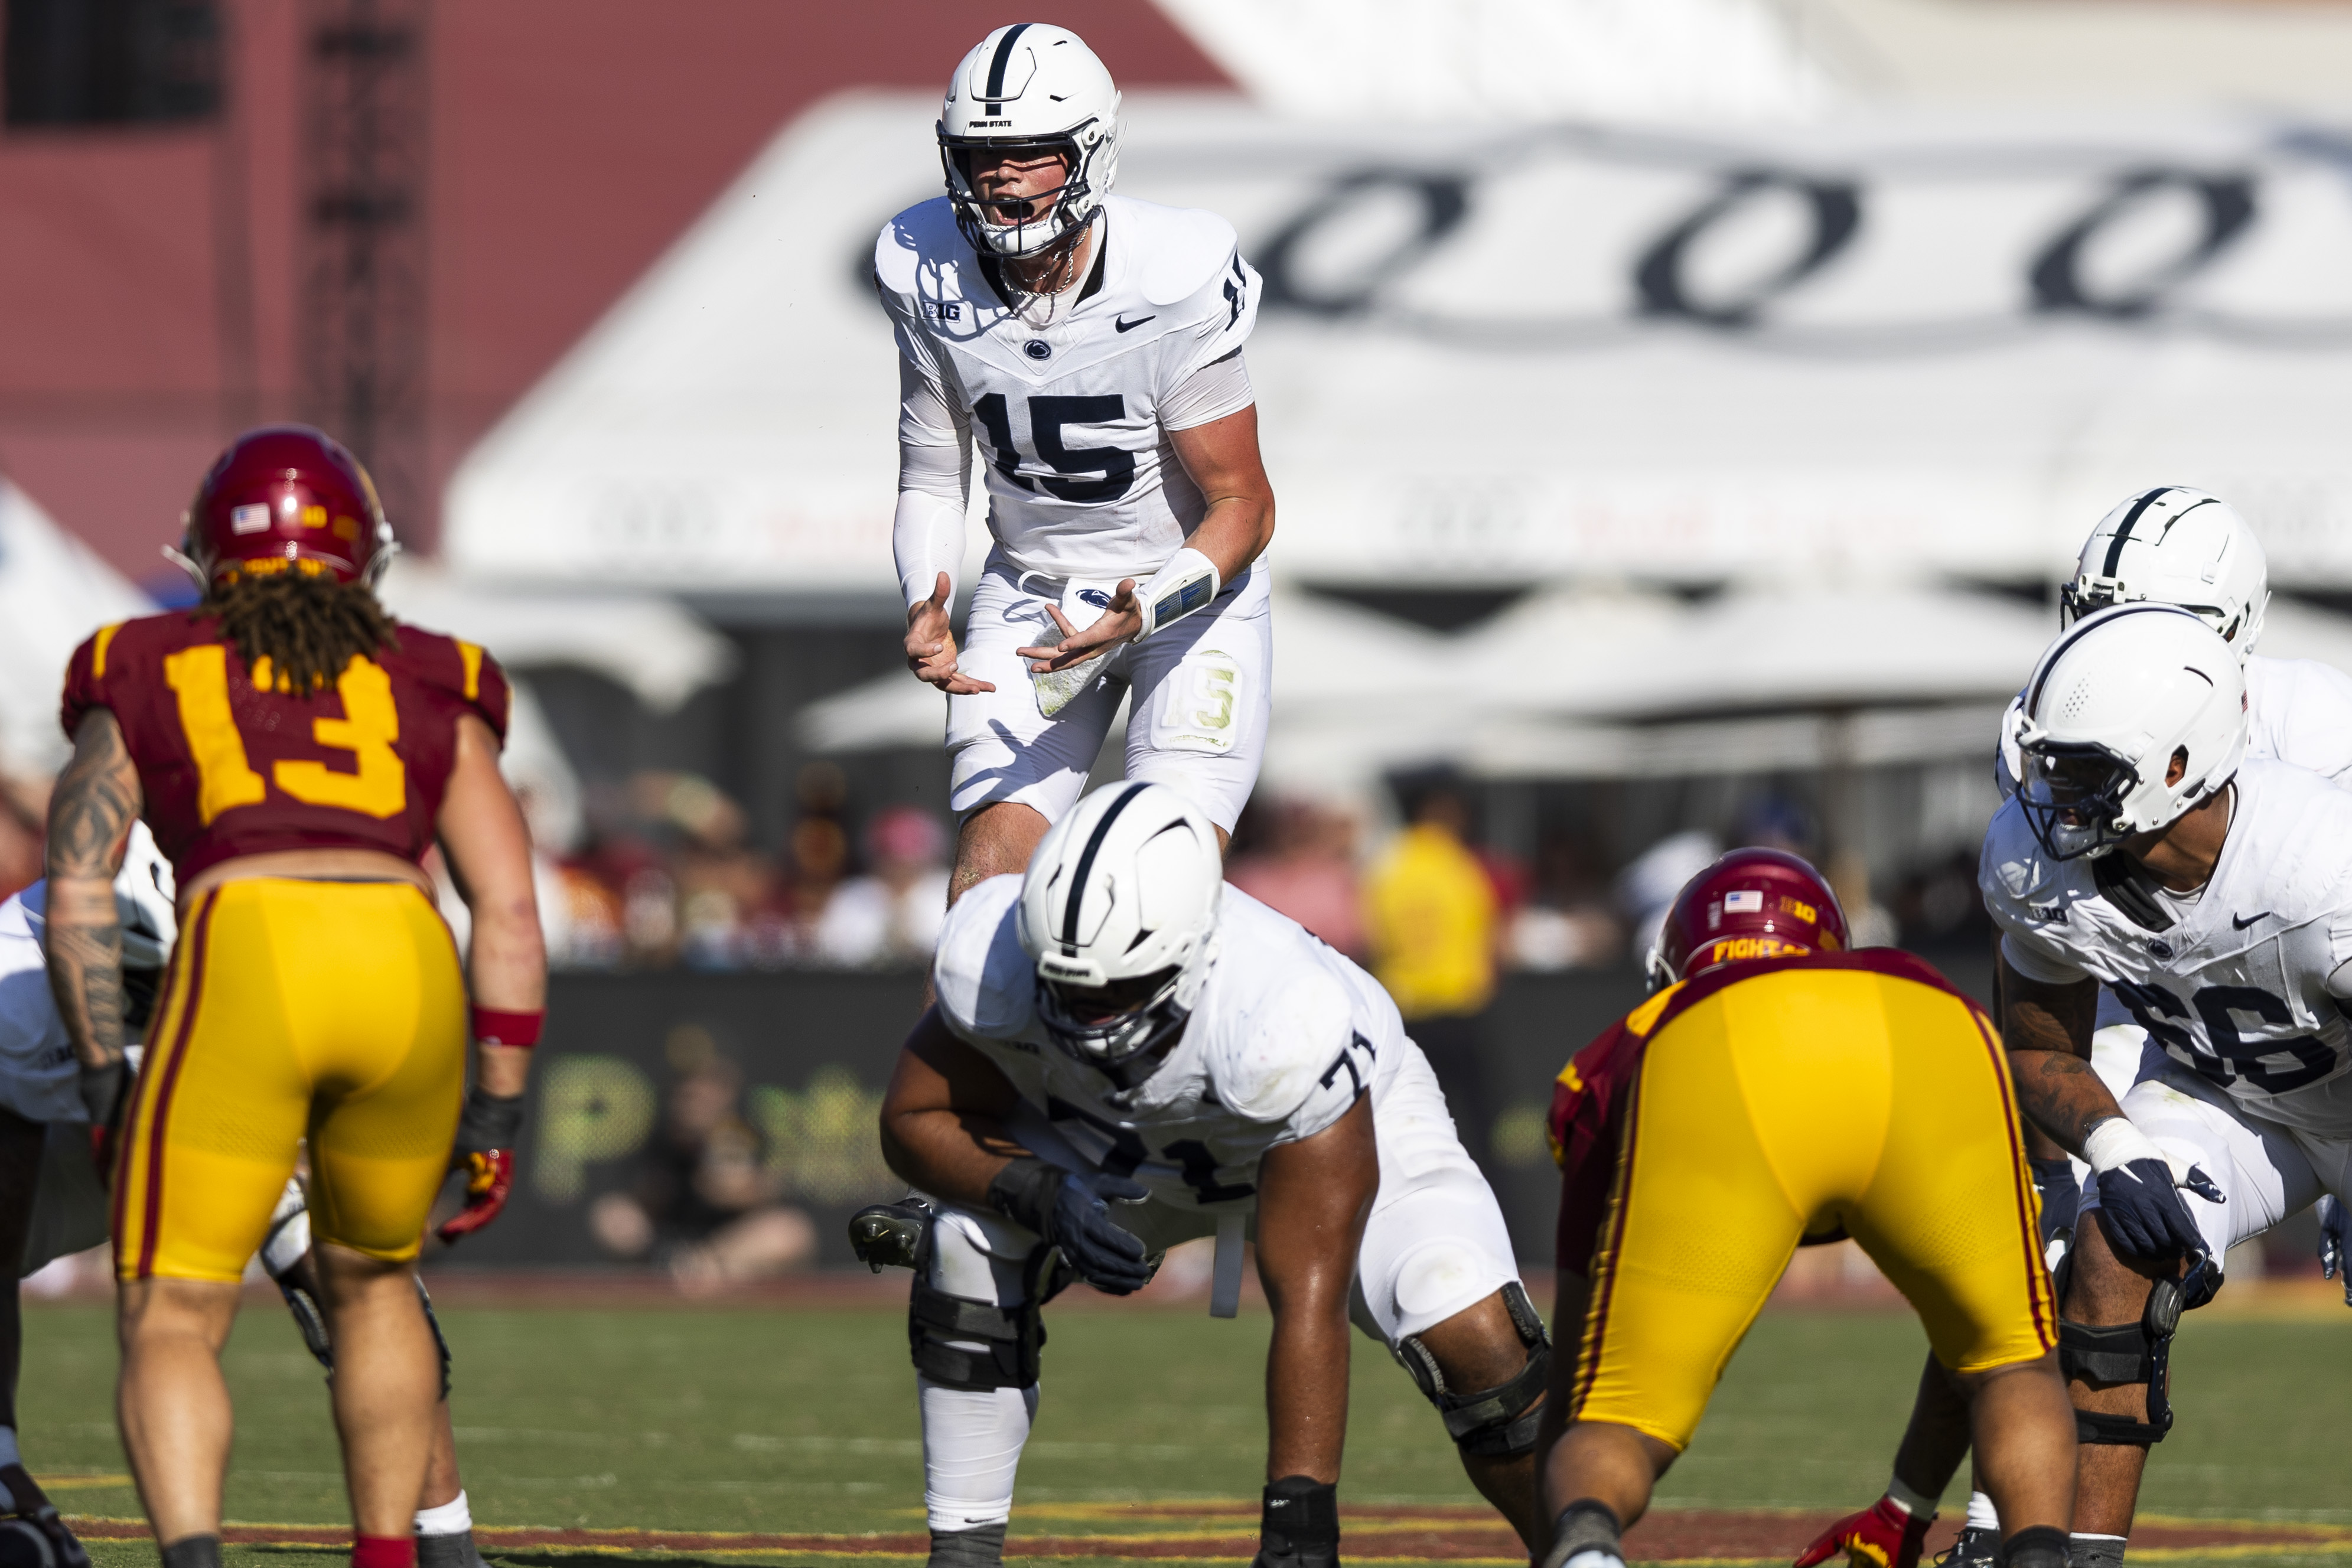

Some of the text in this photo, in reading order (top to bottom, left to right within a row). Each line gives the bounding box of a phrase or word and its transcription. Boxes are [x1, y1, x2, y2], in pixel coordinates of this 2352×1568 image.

[972, 392, 1137, 502] 15
[163, 644, 406, 828] 13
[1161, 666, 1235, 730] 15
[1318, 1028, 1376, 1101] 71
[2104, 977, 2338, 1095] 66
